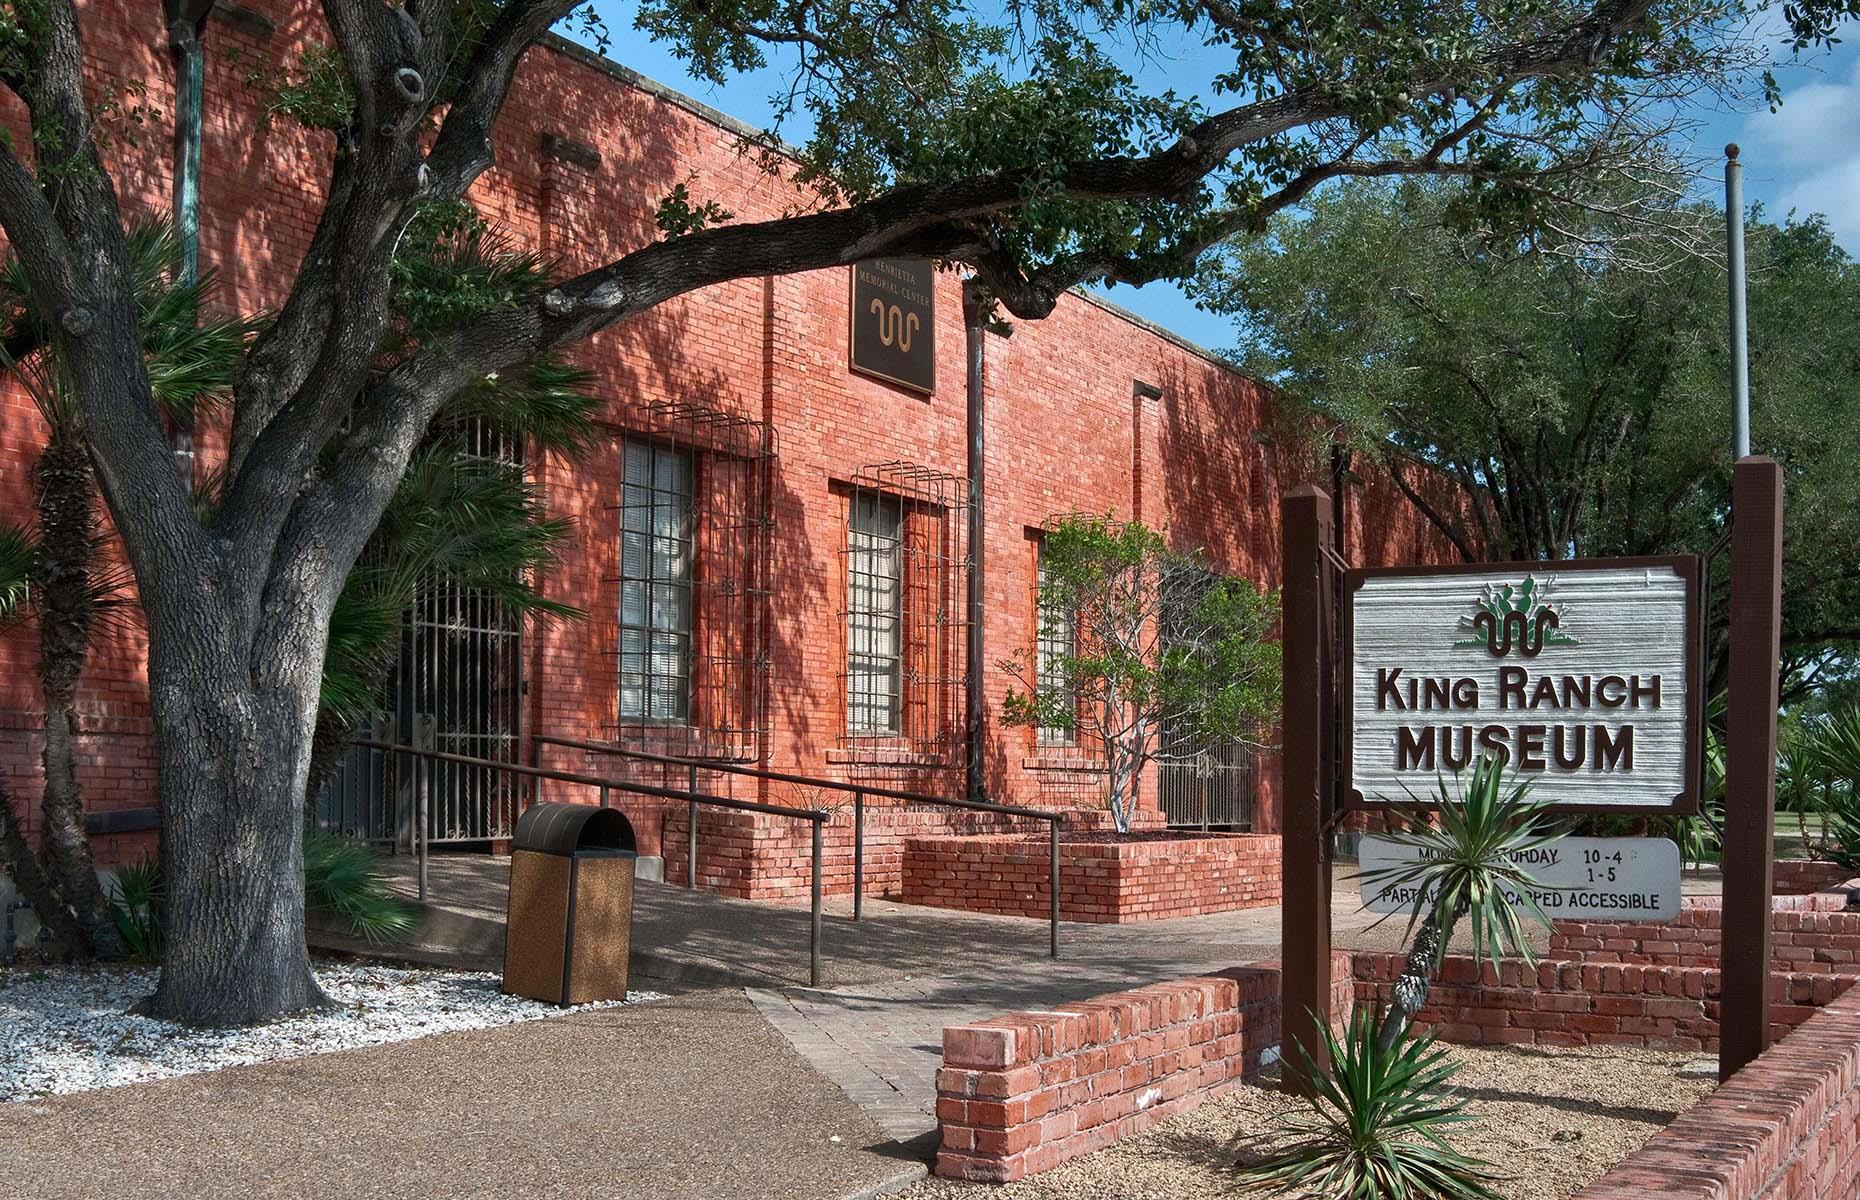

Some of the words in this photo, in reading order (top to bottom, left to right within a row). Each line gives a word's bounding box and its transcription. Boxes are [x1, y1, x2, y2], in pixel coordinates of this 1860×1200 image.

[860, 270, 898, 296] MEMORIAL
[901, 287, 929, 306] CENTER
[1377, 667, 1480, 711] KING
[1498, 665, 1661, 711] RANCH
[1398, 724, 1635, 771] MUSEUM
[1568, 891, 1660, 910] ACCESSIBLE
